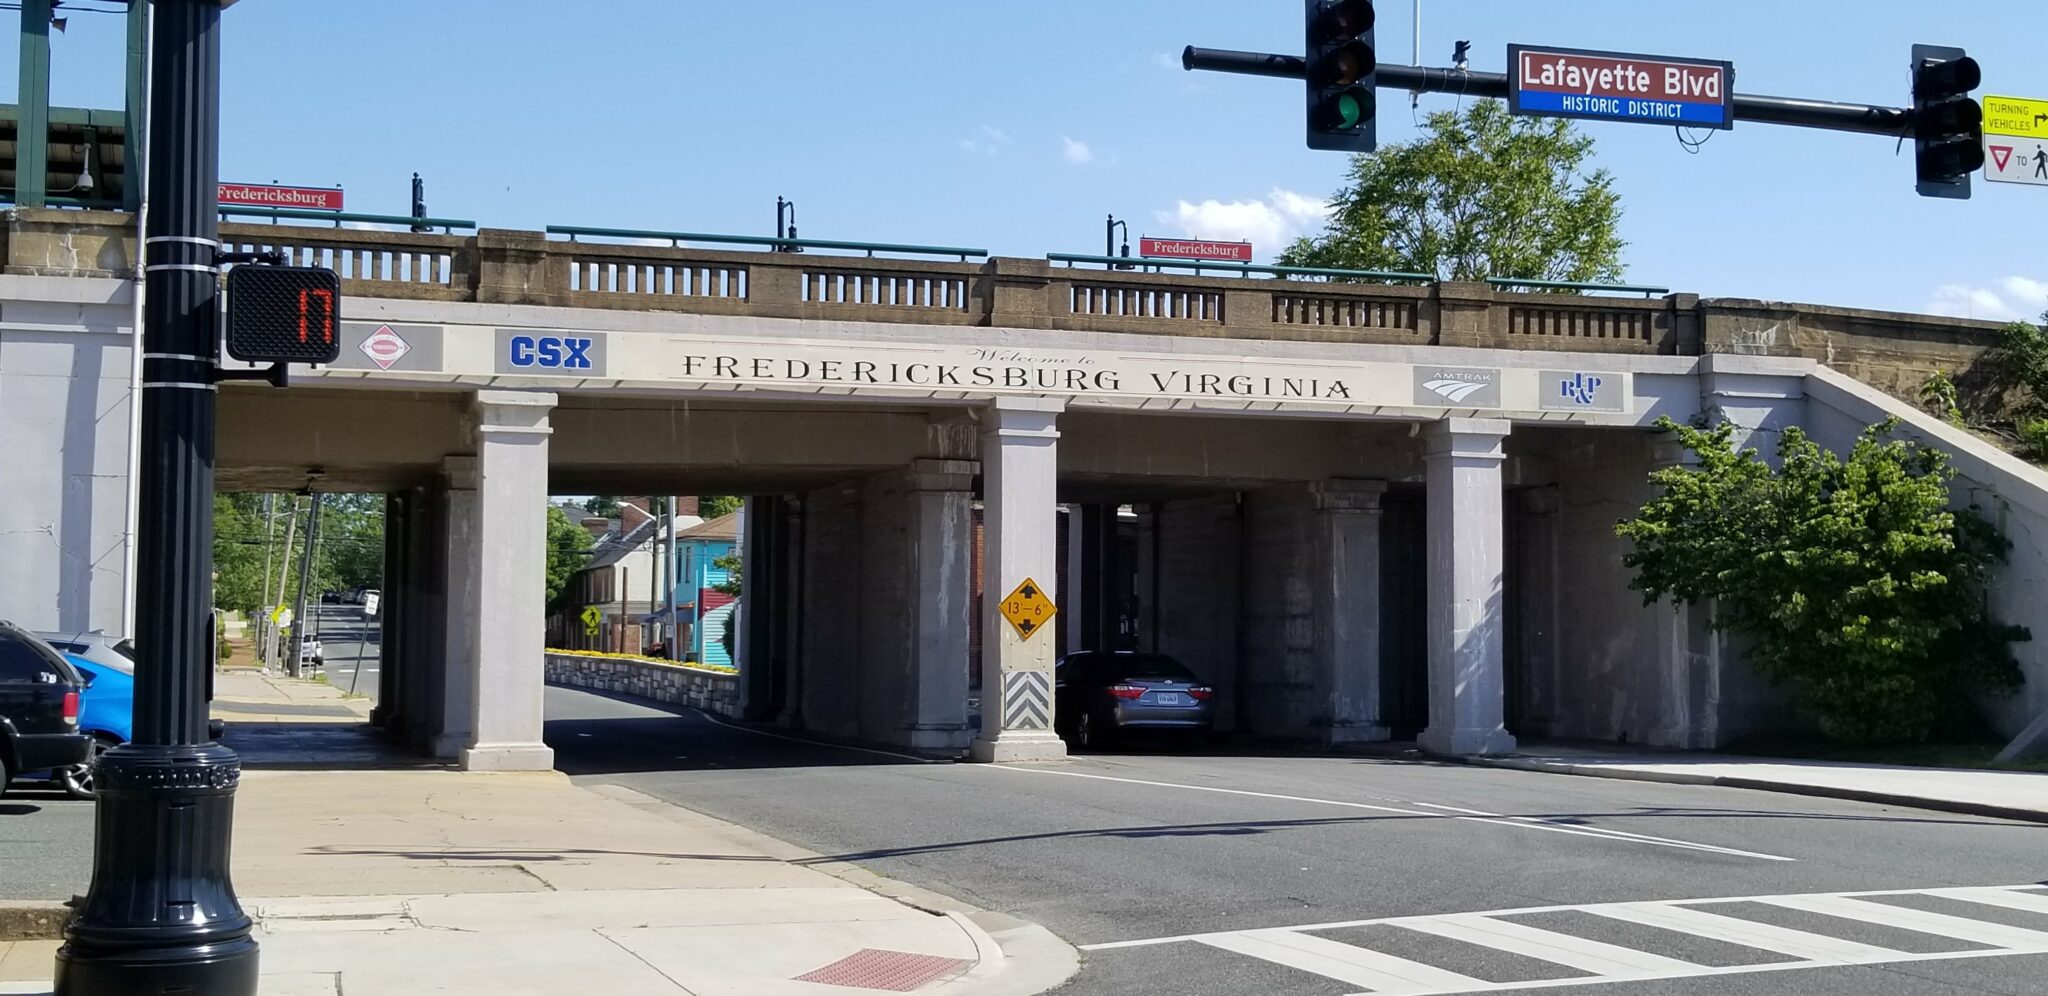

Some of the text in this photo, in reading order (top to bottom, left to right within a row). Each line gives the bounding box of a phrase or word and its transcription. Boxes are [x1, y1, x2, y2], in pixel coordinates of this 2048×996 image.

[1524, 56, 1719, 98] Lafayette Blvd
[1563, 96, 1682, 118] HISTORIC DISTRICT
[1989, 103, 2029, 115] TURNING
[1989, 119, 2030, 131] VEHICLES
[2016, 155, 2027, 166] TO
[217, 186, 326, 207] Fredericksburg
[1154, 241, 1239, 258] Fredericksburg
[299, 288, 333, 344] 17
[510, 335, 593, 370] CSX
[966, 348, 1095, 364] Welcome to
[683, 355, 1352, 399] FREDERICKSBURG VIRGINIA
[1433, 372, 1491, 381] AMTRAK
[40, 671, 57, 684] TB
